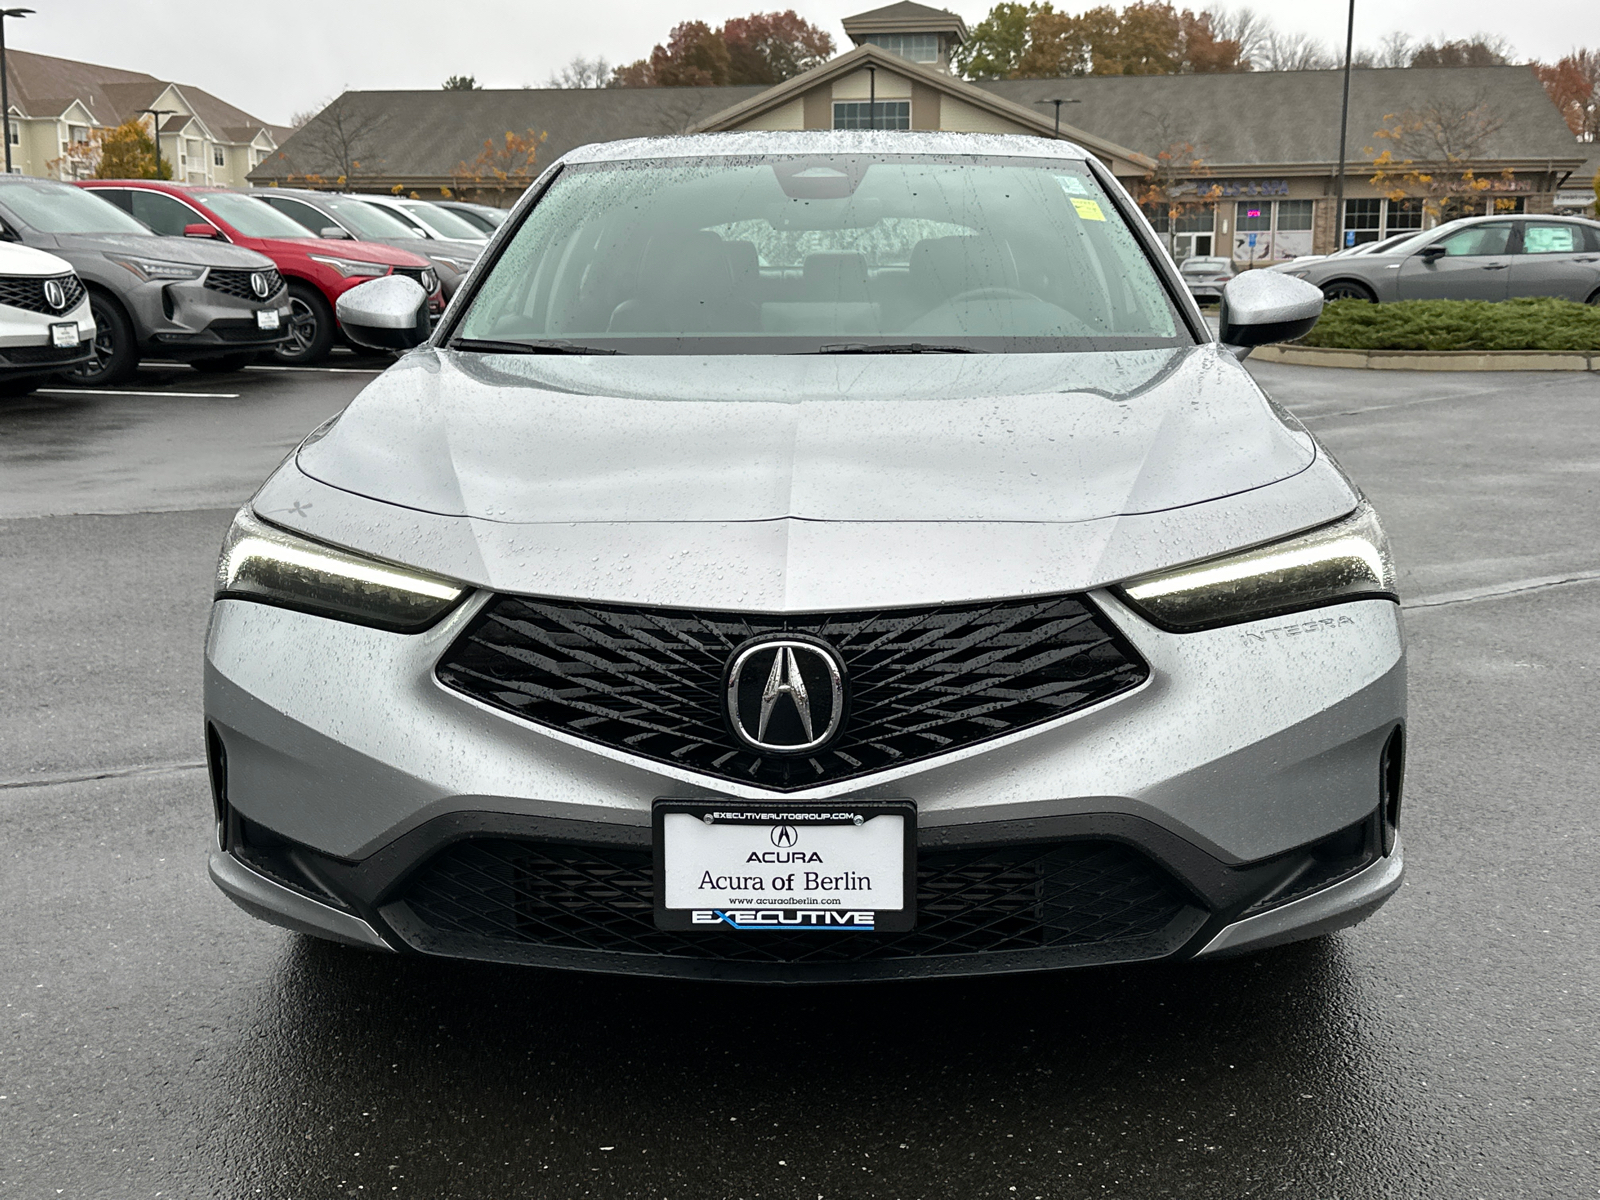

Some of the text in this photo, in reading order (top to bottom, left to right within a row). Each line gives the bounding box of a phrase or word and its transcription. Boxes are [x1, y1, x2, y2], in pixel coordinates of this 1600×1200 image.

[1261, 180, 1289, 196] SPA
[1240, 616, 1355, 646] INTEGRA
[714, 811, 854, 821] EXECUTIVEAUTOGROUP.COM
[746, 851, 823, 863] ACURA
[698, 871, 872, 891] Acura of Berlin
[729, 897, 841, 905] www.acuraofberlin.com
[692, 911, 874, 925] EXECUTIVE
